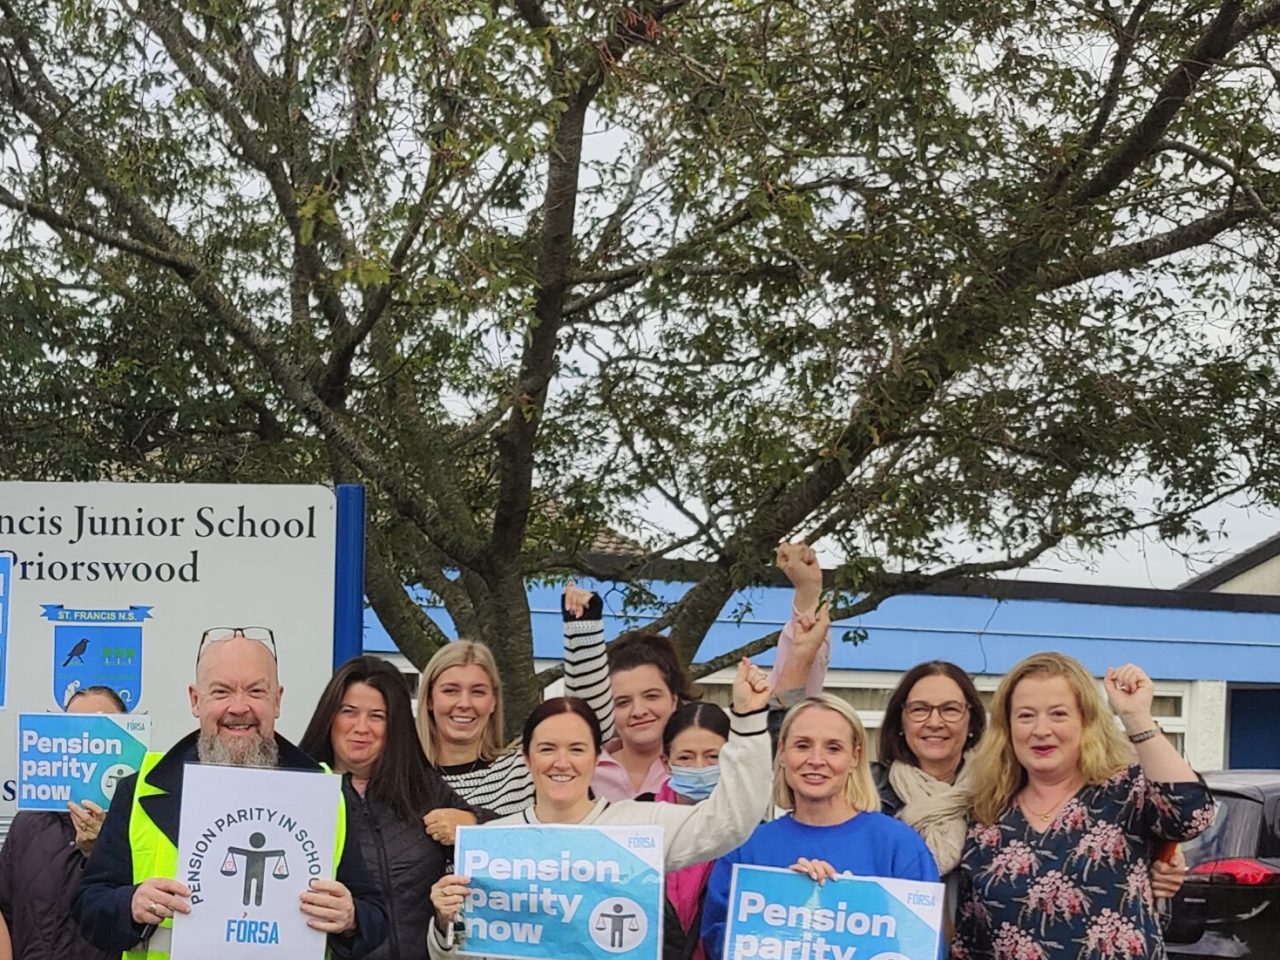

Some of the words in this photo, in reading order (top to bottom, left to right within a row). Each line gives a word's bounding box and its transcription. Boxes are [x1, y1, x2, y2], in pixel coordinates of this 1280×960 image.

[69, 505, 185, 544] Junior
[195, 506, 317, 539] School
[74, 612, 116, 620] FRANCIS
[22, 730, 122, 755] Pension
[22, 755, 97, 783] parity
[22, 783, 71, 800] now
[187, 828, 217, 905] PENSION
[214, 807, 277, 832] PARITY
[278, 814, 297, 832] IN
[464, 850, 619, 883] Pension
[465, 884, 583, 923] parity
[737, 891, 896, 938] Pension
[225, 911, 279, 944] FÓRSA
[465, 917, 543, 944] now
